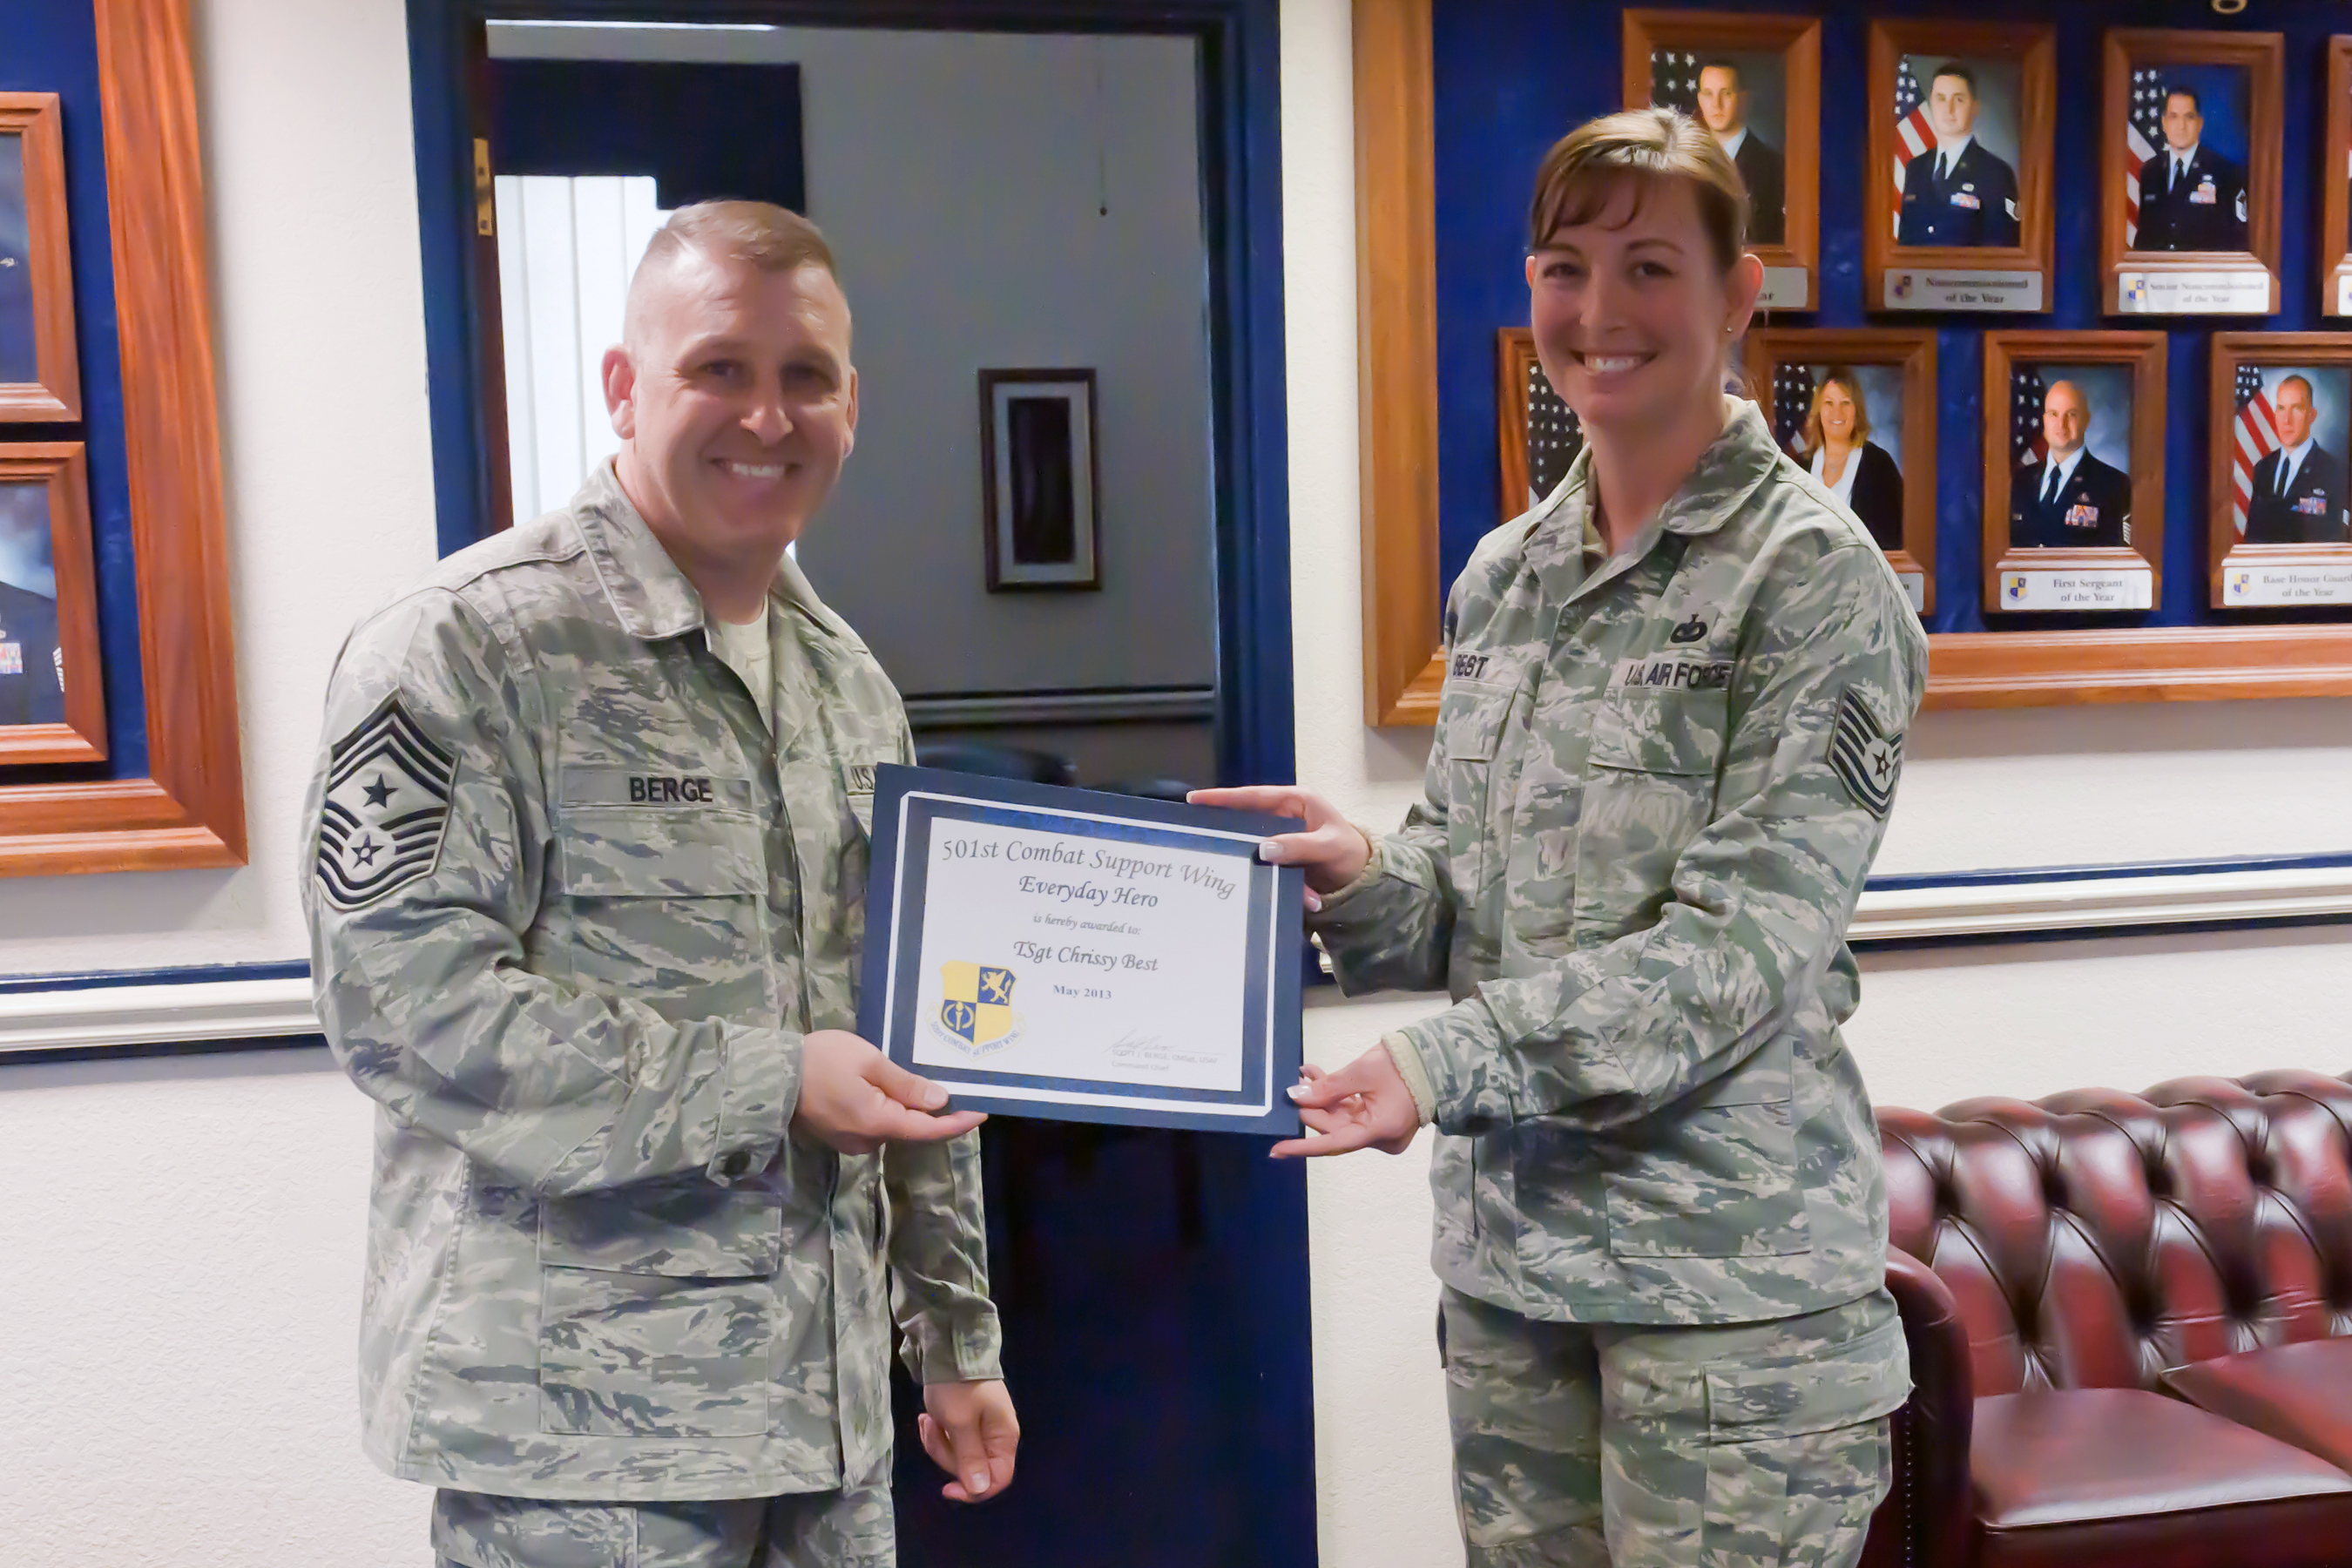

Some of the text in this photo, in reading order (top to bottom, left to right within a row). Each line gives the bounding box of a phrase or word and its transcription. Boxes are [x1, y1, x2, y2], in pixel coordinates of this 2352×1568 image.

[1982, 294, 2004, 303] Year
[2194, 294, 2208, 303] the
[2212, 294, 2230, 303] Year
[2053, 578, 2122, 590] First Sergeant
[2281, 588, 2292, 597] of
[2295, 588, 2310, 597] the
[2060, 592, 2115, 601] of the Year
[1453, 654, 1490, 678] BEST
[1646, 662, 1673, 686] AIR
[629, 775, 713, 802] BERGE
[942, 839, 1237, 900] 501st Combat Support Wing
[1019, 875, 1159, 908] Everyday Hero
[1033, 913, 1142, 935] is hereby awarded to:
[1013, 941, 1159, 972] TSgt Chrissy Best
[1052, 984, 1112, 1000] May 2013
